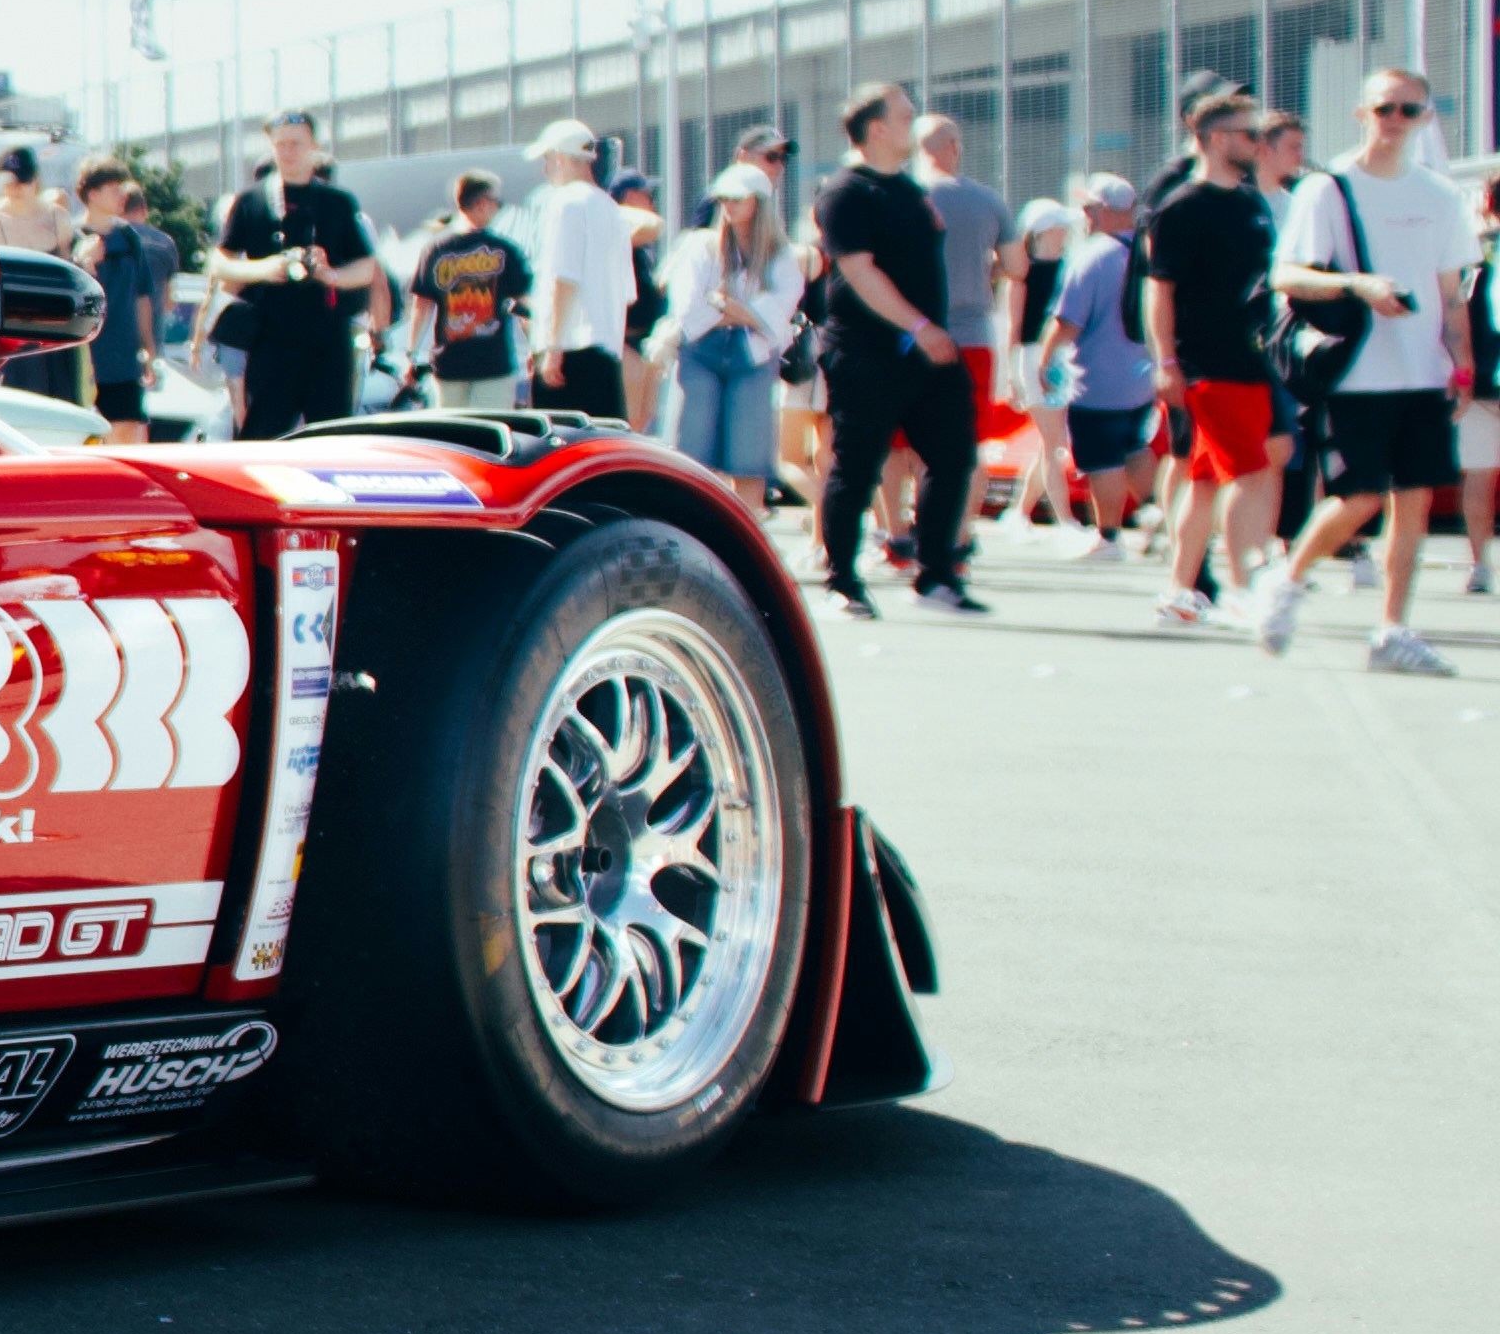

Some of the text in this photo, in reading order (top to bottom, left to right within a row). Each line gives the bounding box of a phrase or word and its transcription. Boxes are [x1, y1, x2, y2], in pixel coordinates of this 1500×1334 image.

[59, 902, 148, 957] GT
[103, 1034, 221, 1060] WERBETECHNIK
[87, 1055, 241, 1099] HÜSCH
